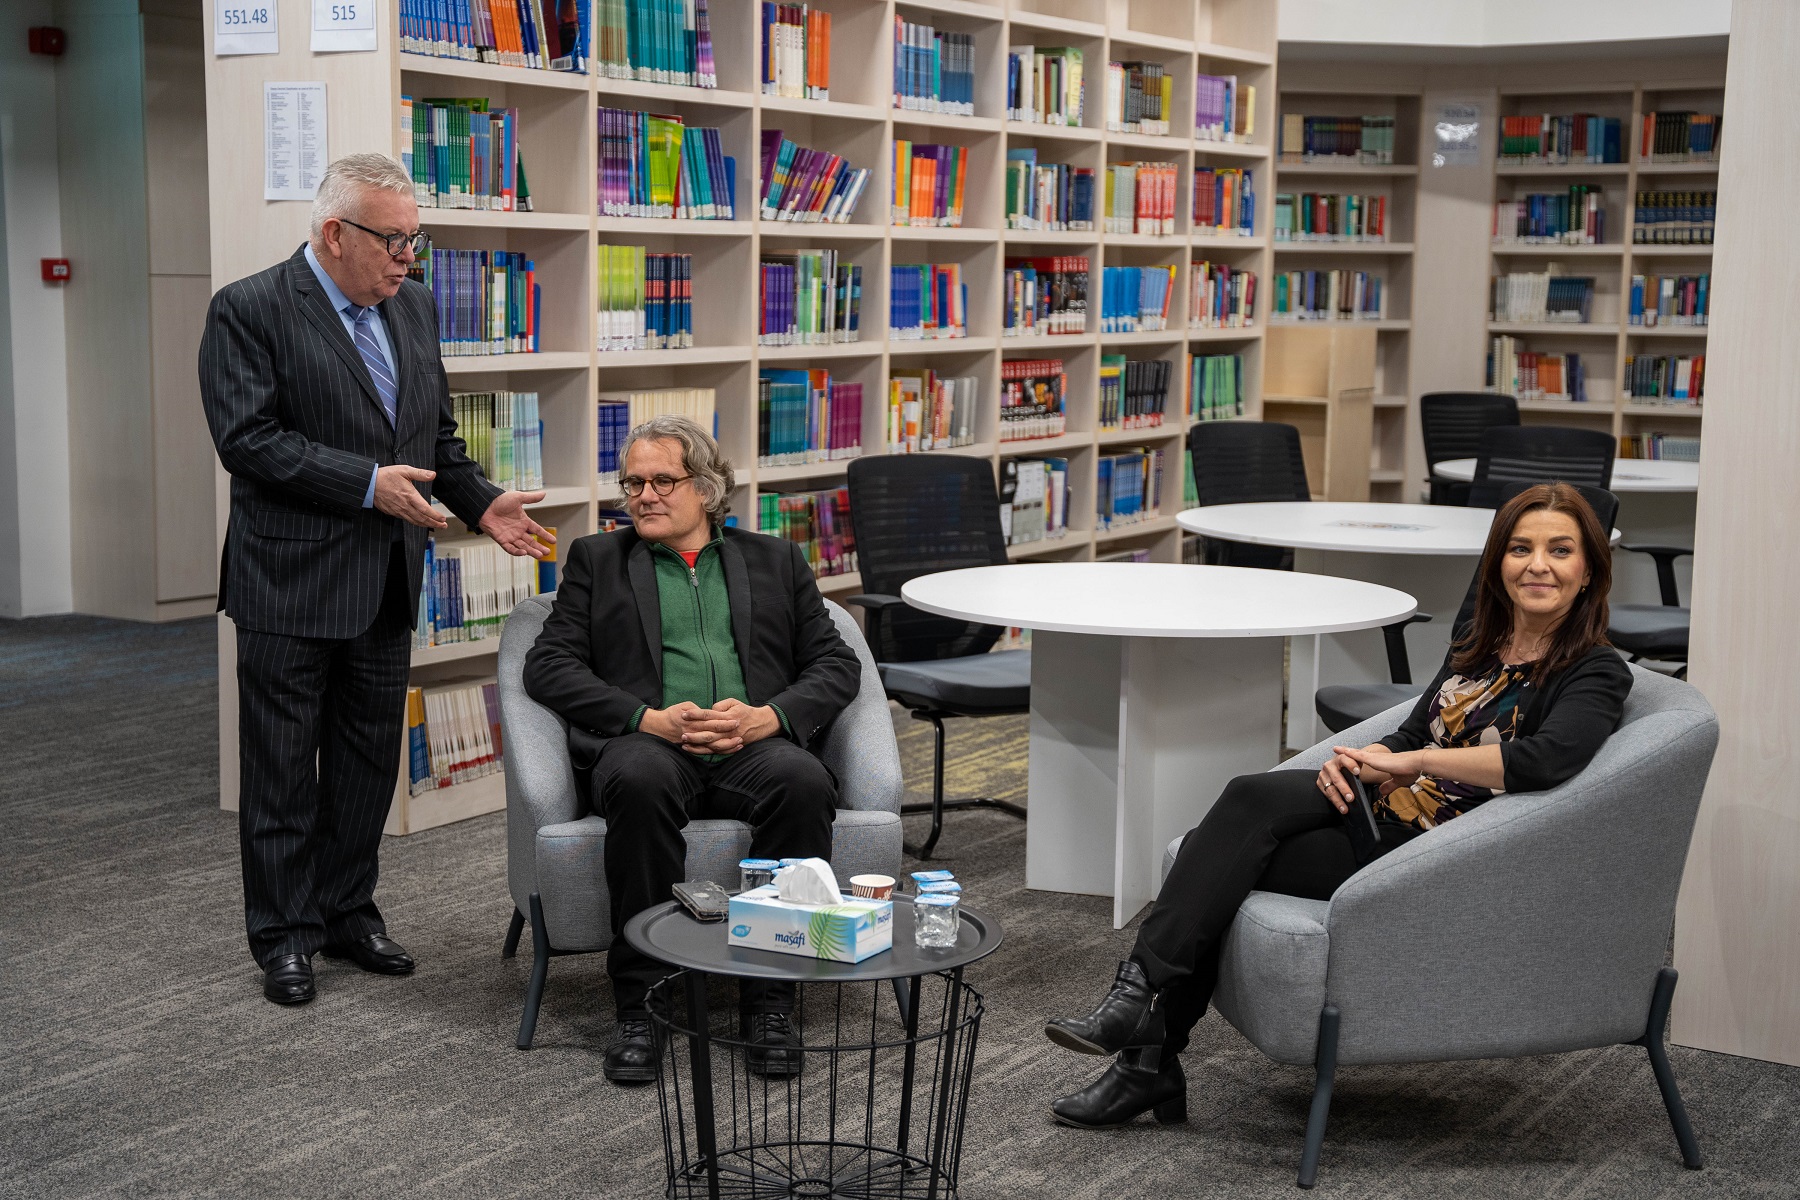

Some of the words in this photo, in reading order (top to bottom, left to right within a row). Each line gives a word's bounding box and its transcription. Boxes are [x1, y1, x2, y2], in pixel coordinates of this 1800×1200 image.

[224, 8, 268, 25] 551.48
[332, 5, 356, 20] 515
[774, 931, 806, 948] masafi
